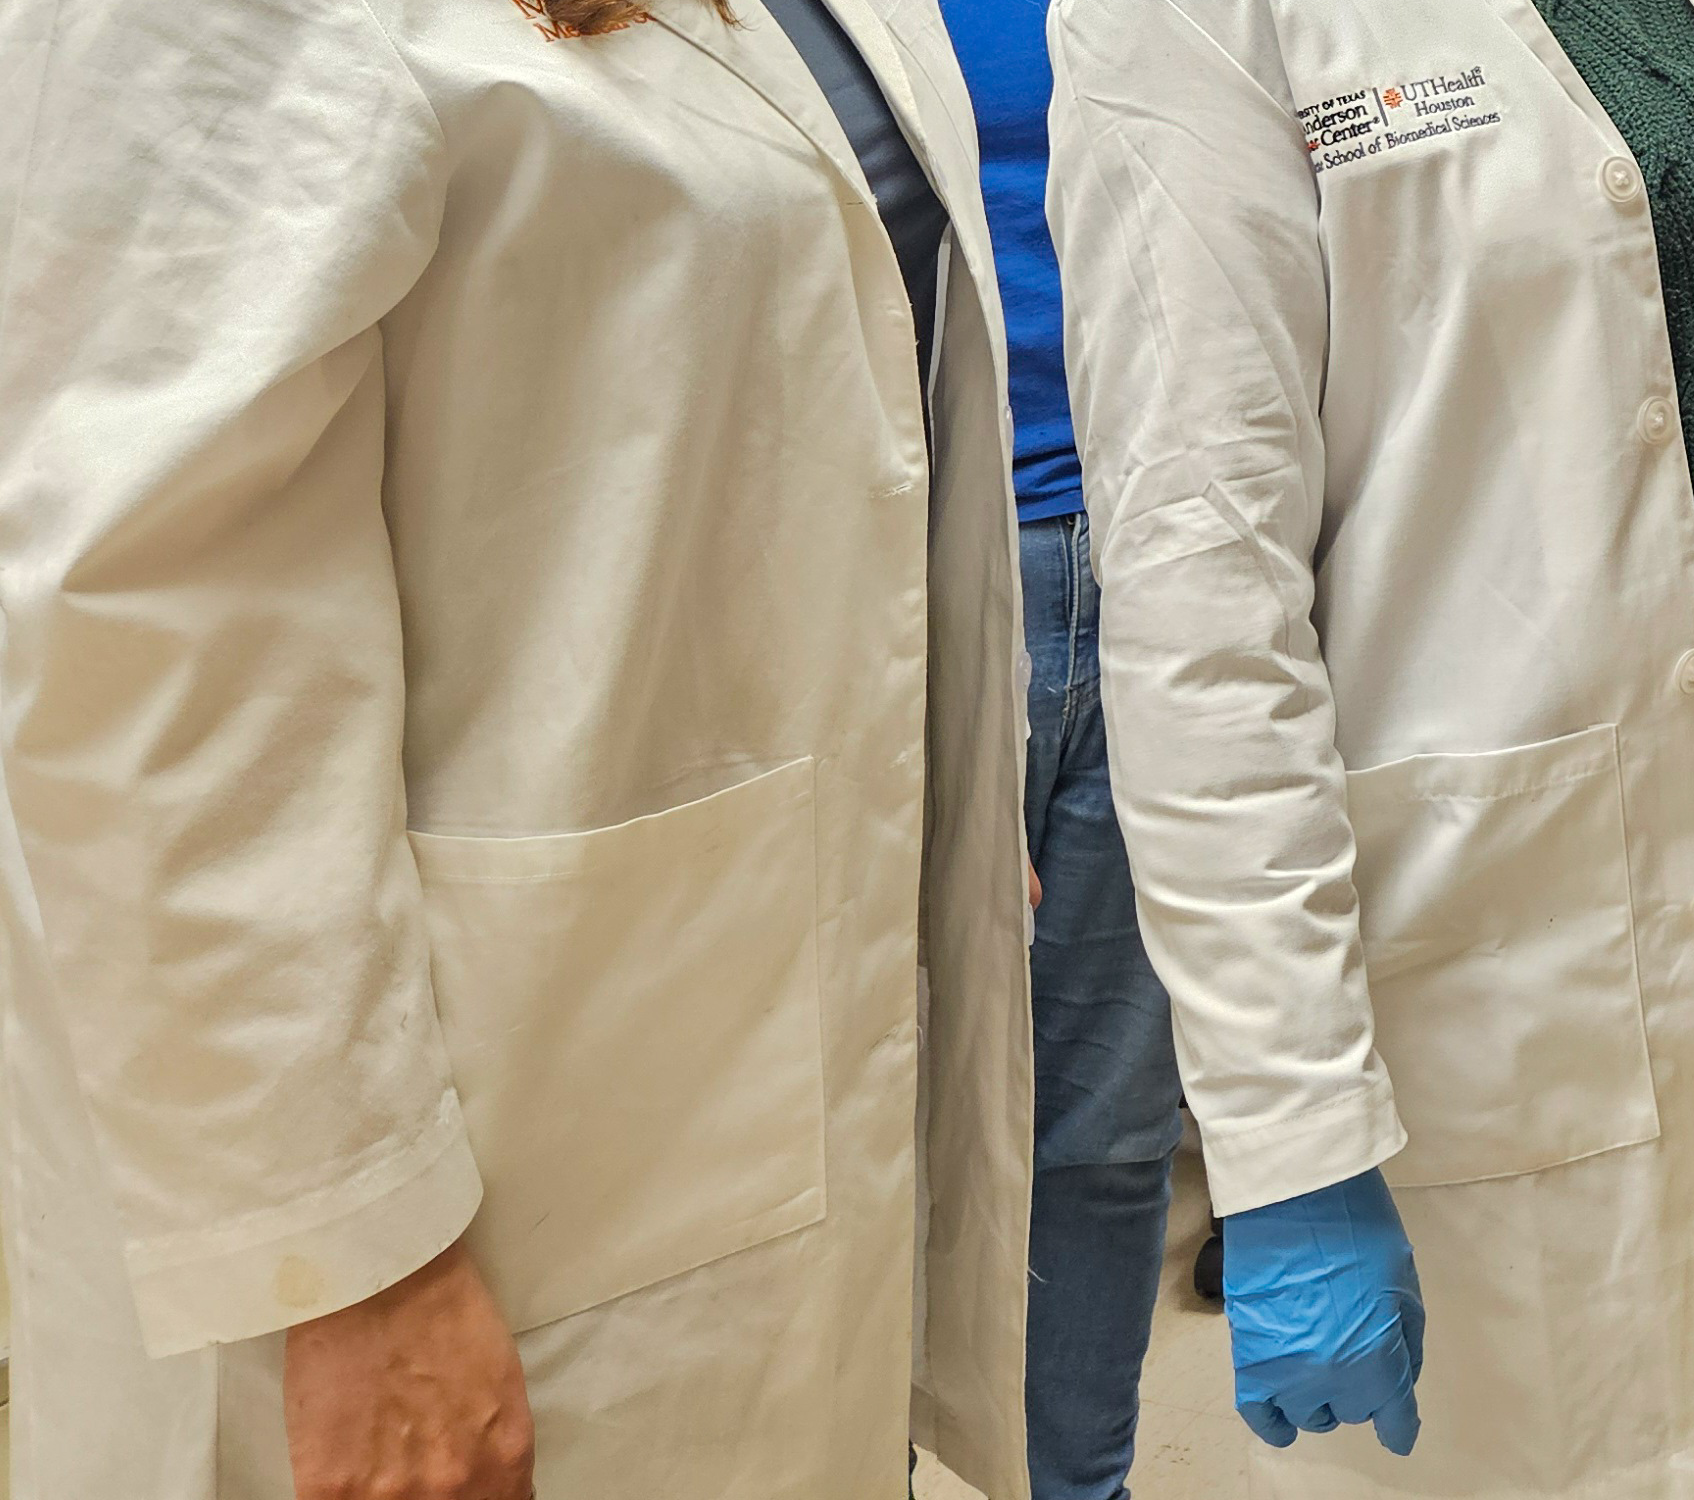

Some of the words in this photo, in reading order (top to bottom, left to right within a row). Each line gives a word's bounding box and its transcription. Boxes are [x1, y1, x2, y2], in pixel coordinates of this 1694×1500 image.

[1321, 99, 1335, 111] OF
[1336, 90, 1367, 107] TEXAS
[1414, 95, 1476, 118] Houston
[1323, 142, 1367, 170] School
[1368, 136, 1383, 155] of
[1386, 117, 1453, 150] Biomedical
[1452, 111, 1501, 131] Sciences
